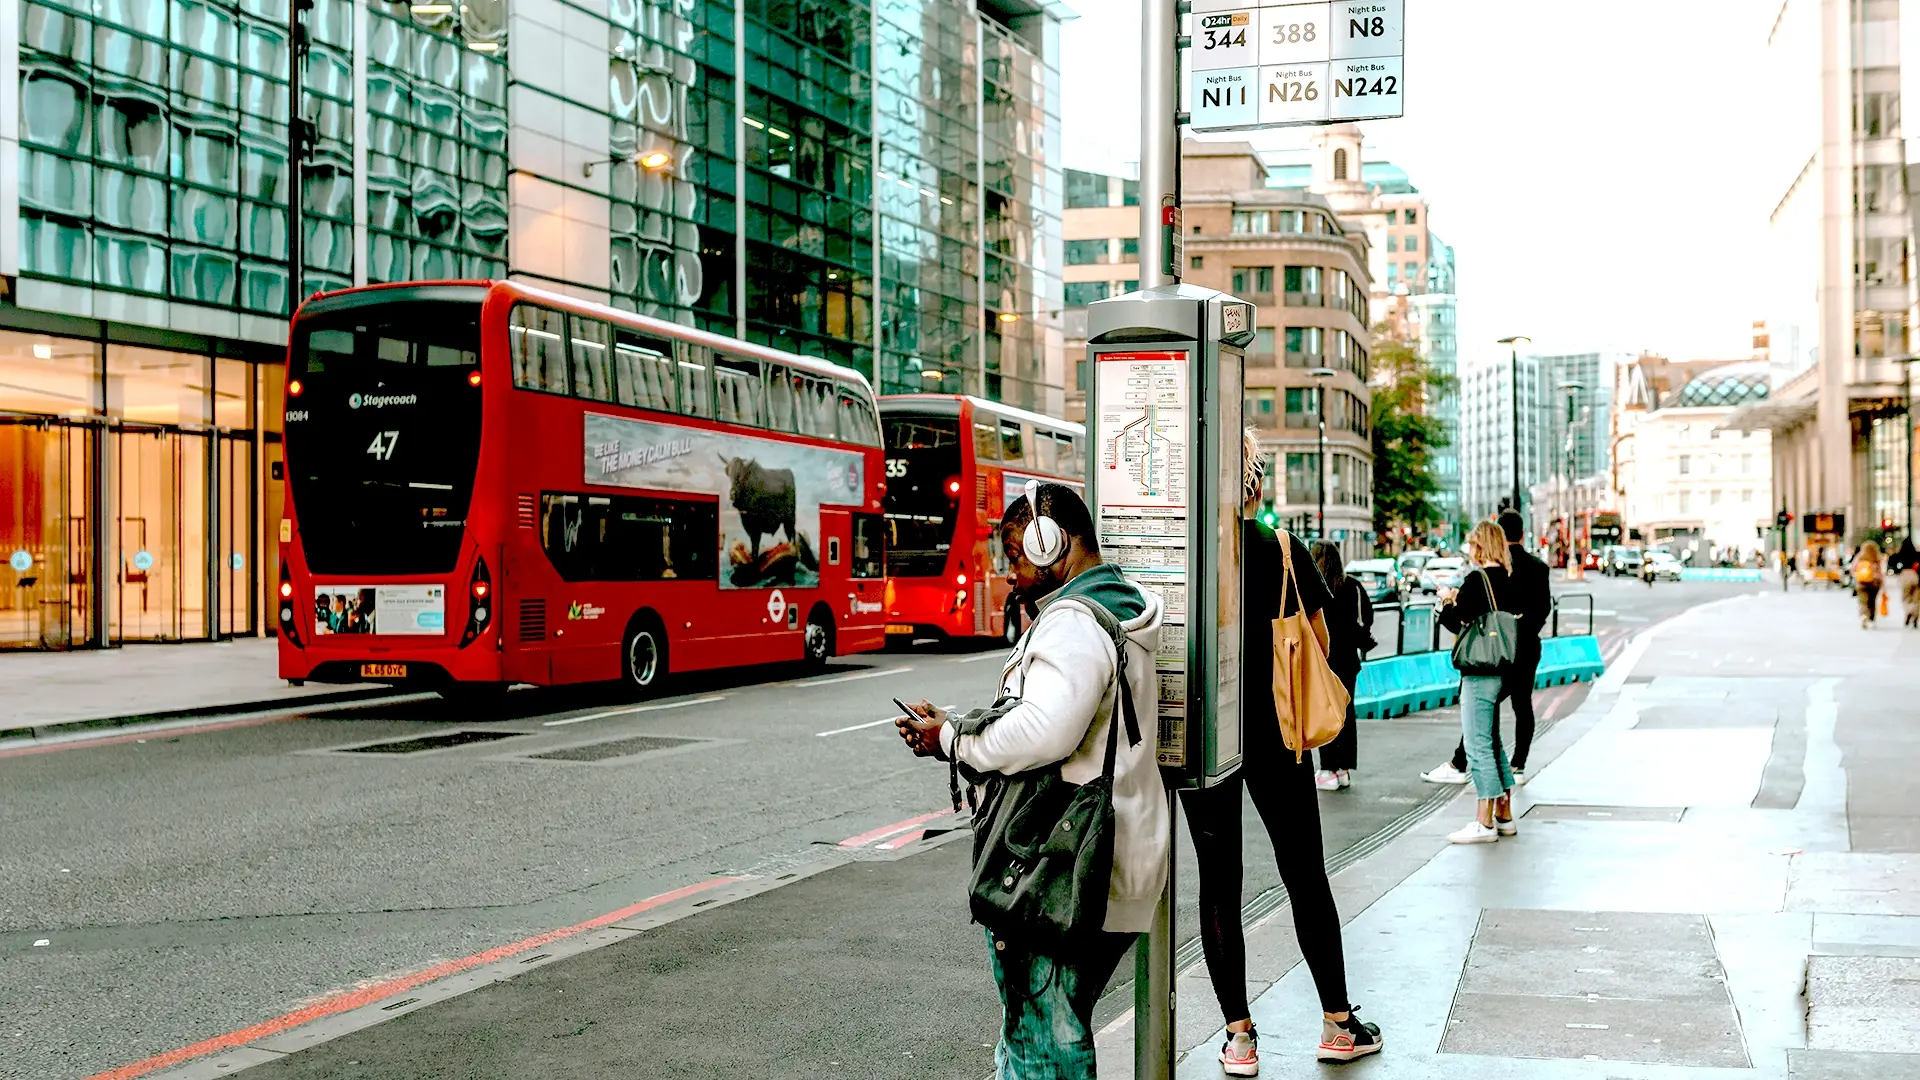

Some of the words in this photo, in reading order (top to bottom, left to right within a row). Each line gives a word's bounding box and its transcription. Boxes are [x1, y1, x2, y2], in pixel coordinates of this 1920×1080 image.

[1348, 6, 1370, 15] Night
[1371, 5, 1386, 13] Bus
[1211, 16, 1231, 26] 24hr
[1349, 16, 1385, 39] N8
[1204, 28, 1247, 50] 344
[1272, 22, 1316, 45] 388
[1275, 70, 1297, 79] Night
[1299, 69, 1313, 77] Bus
[1347, 64, 1369, 73] Night
[1371, 63, 1385, 71] Bus
[1206, 76, 1227, 84] Night
[1335, 76, 1397, 98] N242
[1202, 86, 1246, 108] N11
[1269, 81, 1319, 103] N26
[363, 393, 417, 408] Stagecoach
[366, 430, 400, 461] 47
[594, 444, 604, 458] BE
[604, 440, 620, 456] LIKE
[601, 454, 619, 475] THE
[618, 447, 648, 469] MONEY
[646, 443, 671, 462] CALM
[670, 438, 692, 457] BULL
[885, 459, 908, 478] 35
[364, 663, 385, 676] BL65
